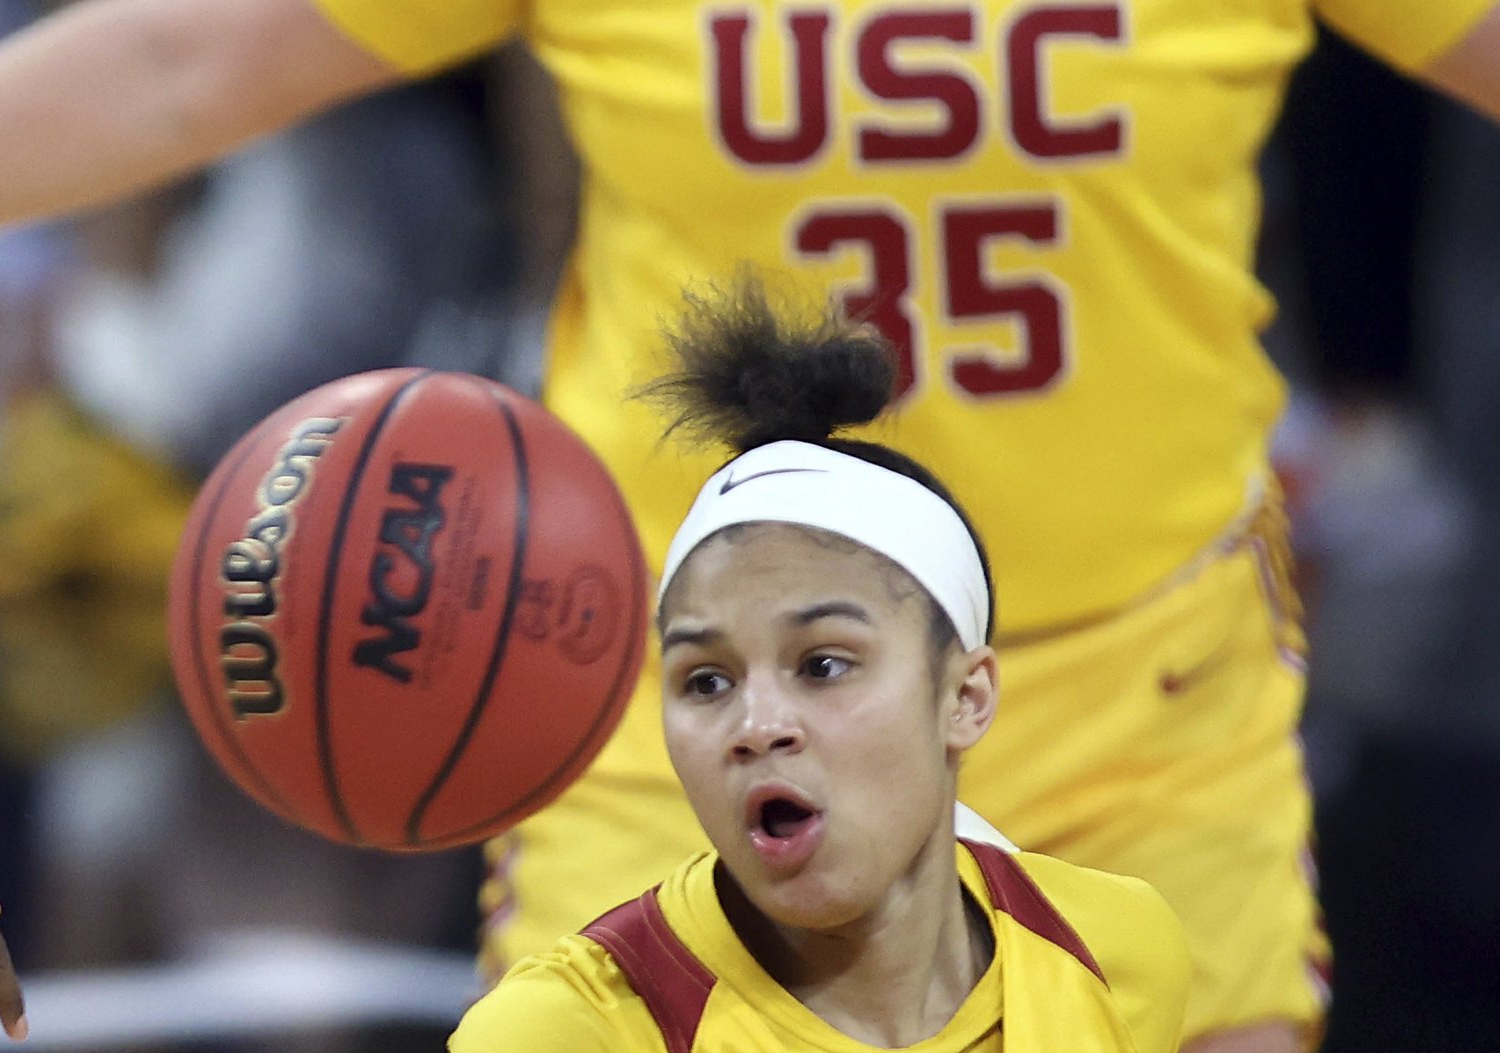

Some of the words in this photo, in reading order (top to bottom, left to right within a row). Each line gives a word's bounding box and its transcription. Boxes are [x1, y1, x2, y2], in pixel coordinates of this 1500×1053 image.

[706, 0, 1128, 172] USC
[788, 196, 1072, 404] 35
[351, 461, 457, 684] NCAA
